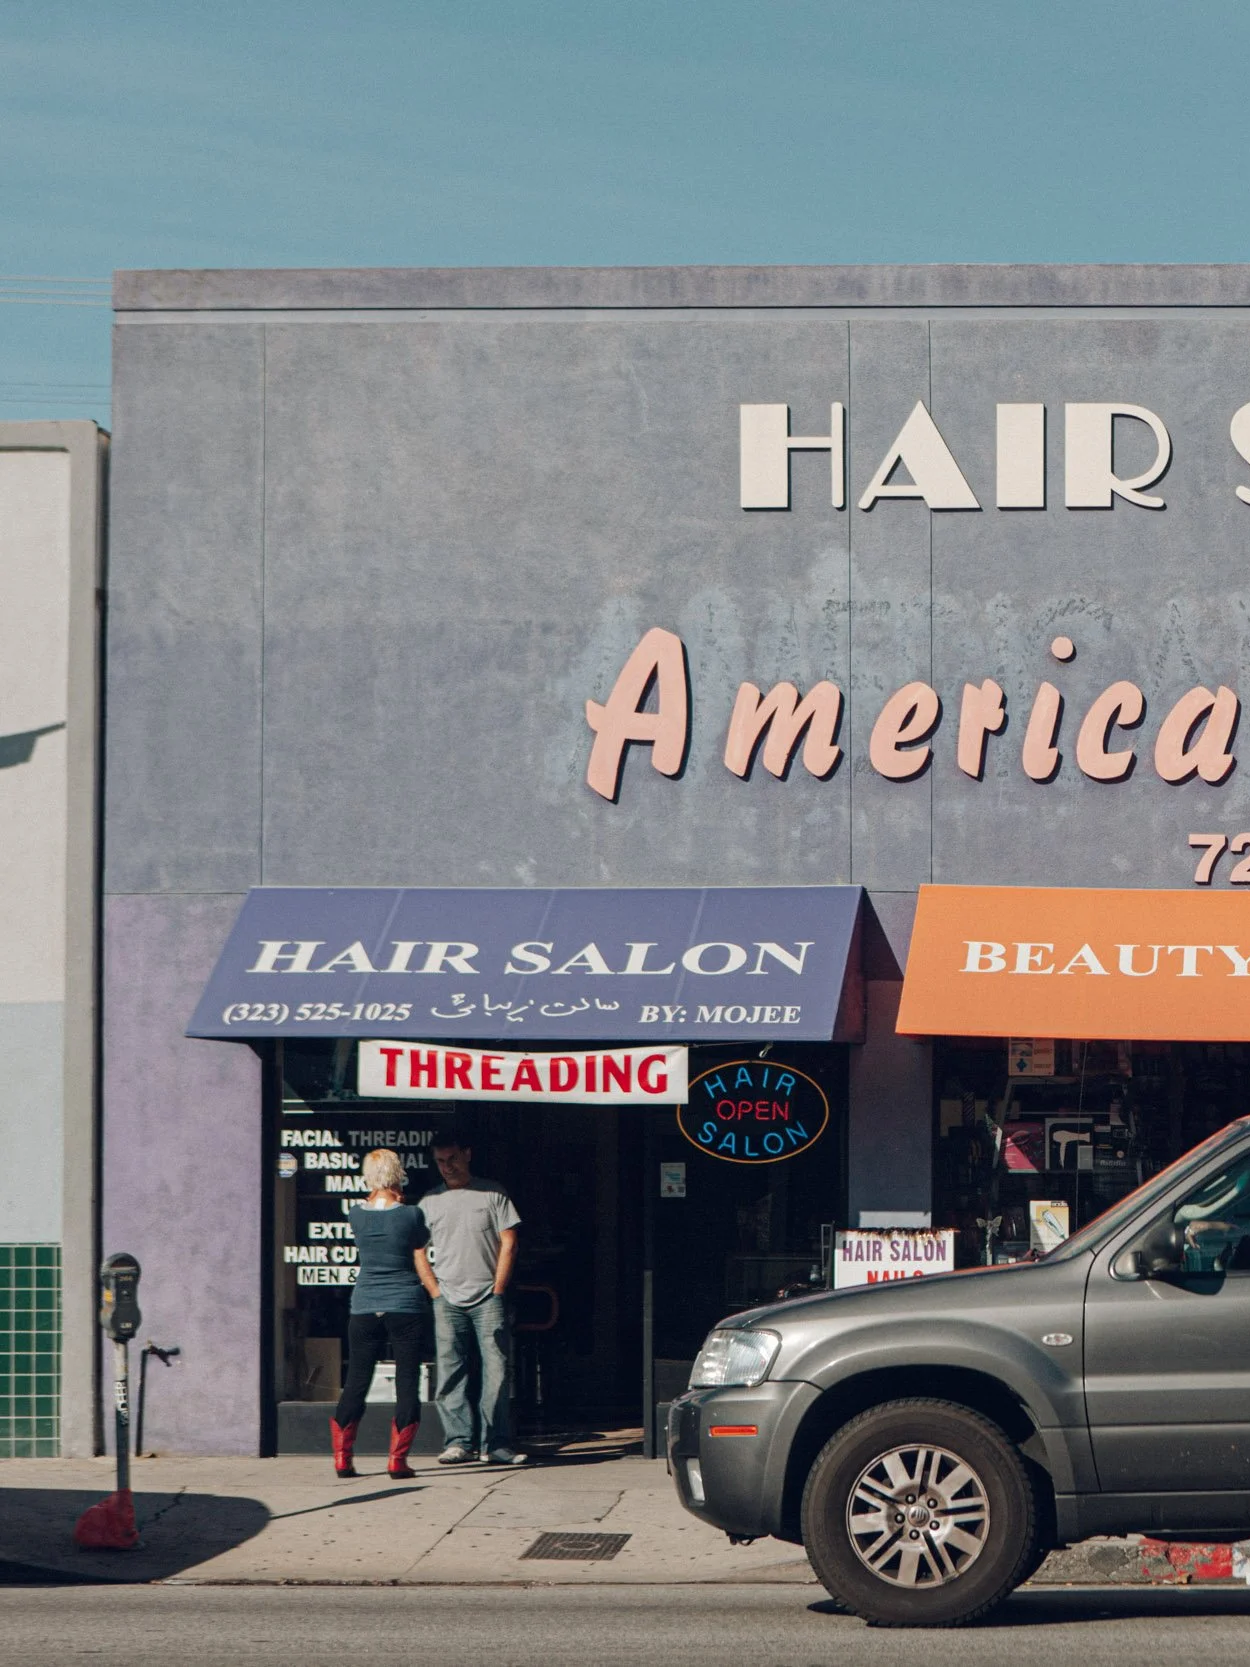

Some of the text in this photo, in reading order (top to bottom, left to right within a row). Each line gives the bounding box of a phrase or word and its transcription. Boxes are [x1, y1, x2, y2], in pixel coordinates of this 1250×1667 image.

[740, 400, 1171, 509] HAIR
[247, 940, 815, 976] HAIR SALON
[222, 1002, 412, 1025] (323) 525-1025
[638, 1005, 801, 1024] BY: MOJEE
[380, 1048, 669, 1095] THREADING
[704, 1067, 796, 1099] HAIR
[716, 1099, 789, 1121] OPEN
[281, 1130, 343, 1147] FACIAL
[698, 1121, 808, 1157] SALON
[304, 1152, 360, 1169] BASIC
[284, 1246, 360, 1264] HAIR CU
[842, 1240, 946, 1262] HAIR SALON
[302, 1268, 357, 1283] MEN &
